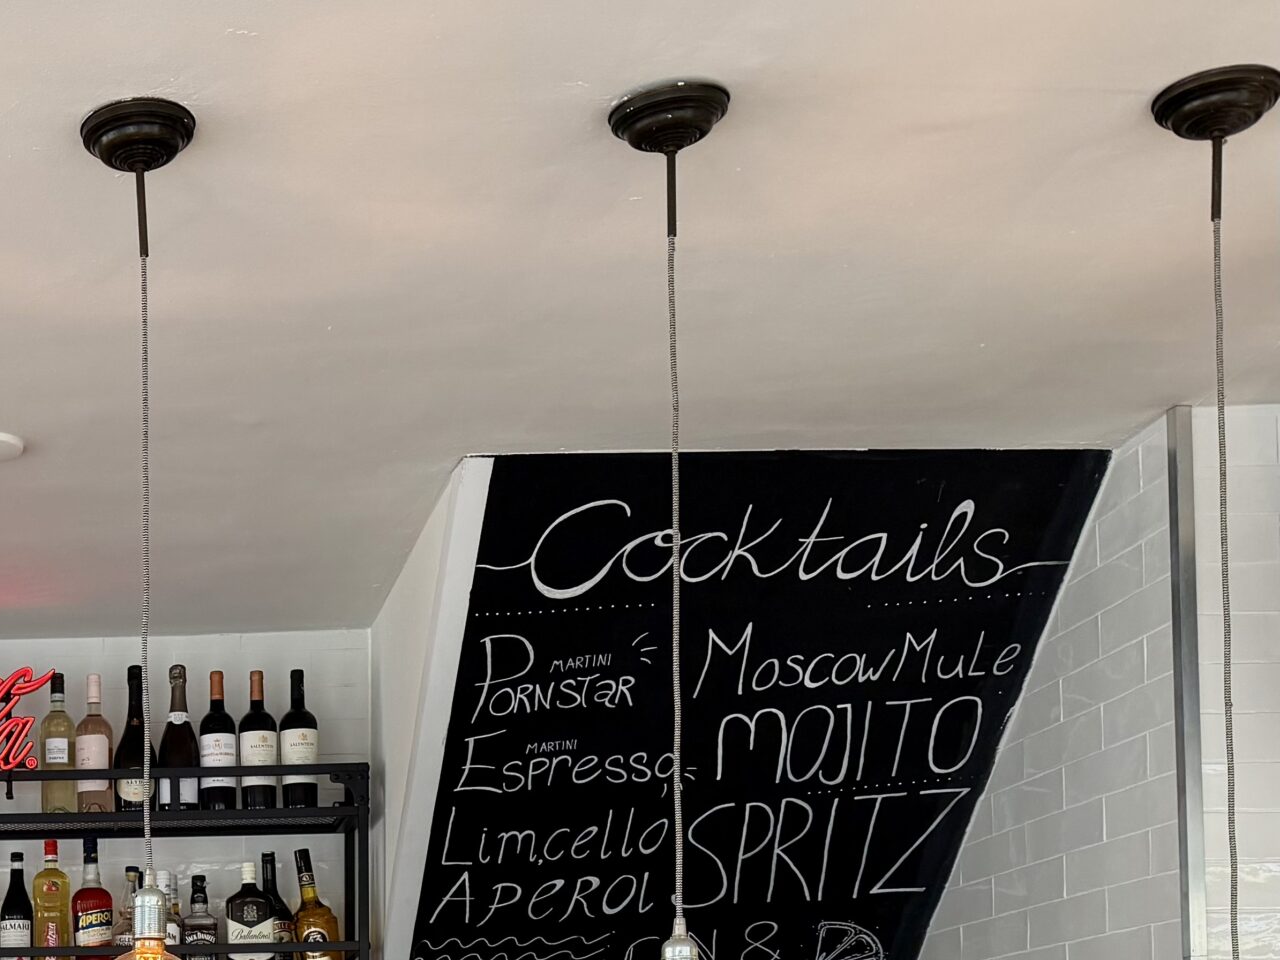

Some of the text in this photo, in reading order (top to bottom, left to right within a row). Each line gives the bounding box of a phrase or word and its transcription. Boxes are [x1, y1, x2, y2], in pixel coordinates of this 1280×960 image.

[528, 497, 1012, 600] Cocktails
[550, 653, 612, 673] MARTINI
[525, 738, 578, 754] MARTINI
[671, 788, 971, 908] SPRITZ
[79, 911, 112, 928] APEROL
